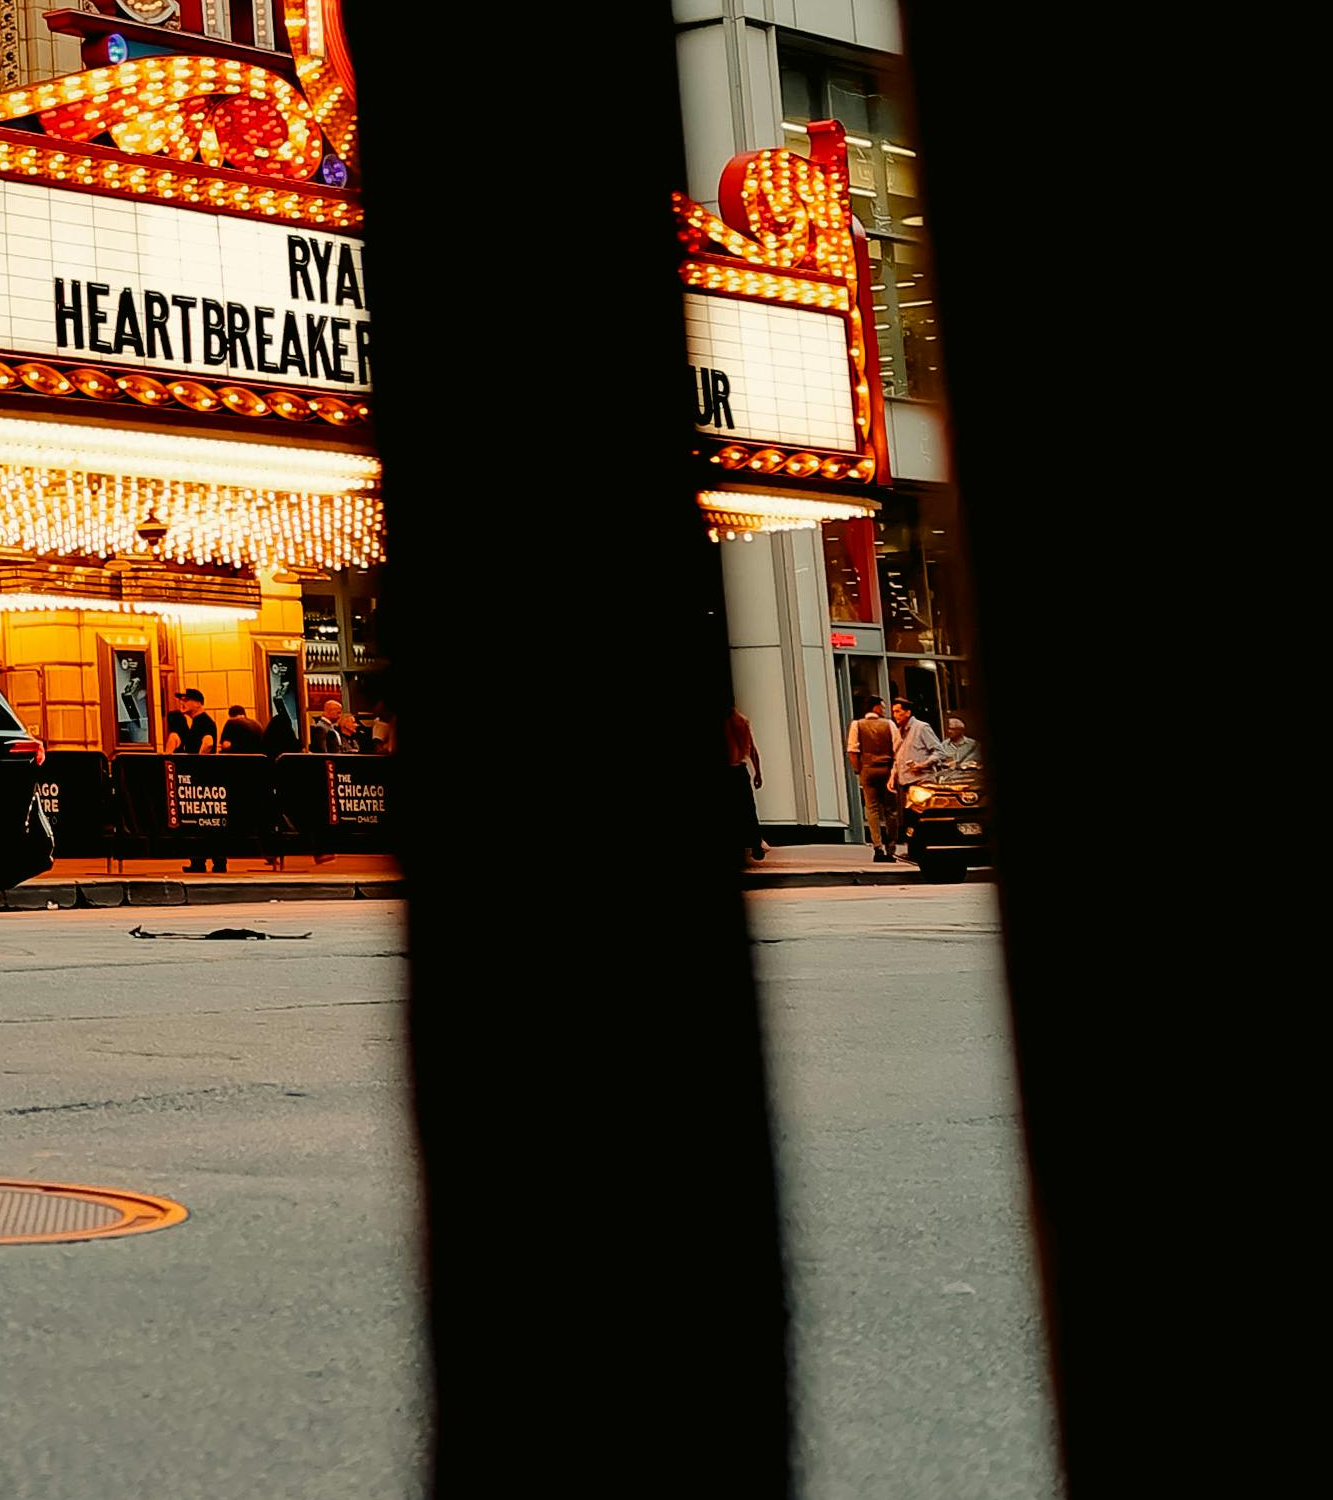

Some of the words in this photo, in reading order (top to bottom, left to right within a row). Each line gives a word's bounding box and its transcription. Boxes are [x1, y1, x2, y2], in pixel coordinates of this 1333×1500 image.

[177, 774, 192, 784] THE
[337, 774, 352, 783] THE
[178, 785, 227, 799] CHICAGO
[337, 784, 385, 797] CHICAGO
[179, 801, 228, 814] THEATRE
[338, 799, 386, 812] THEATRE
[198, 818, 220, 827] CHASE
